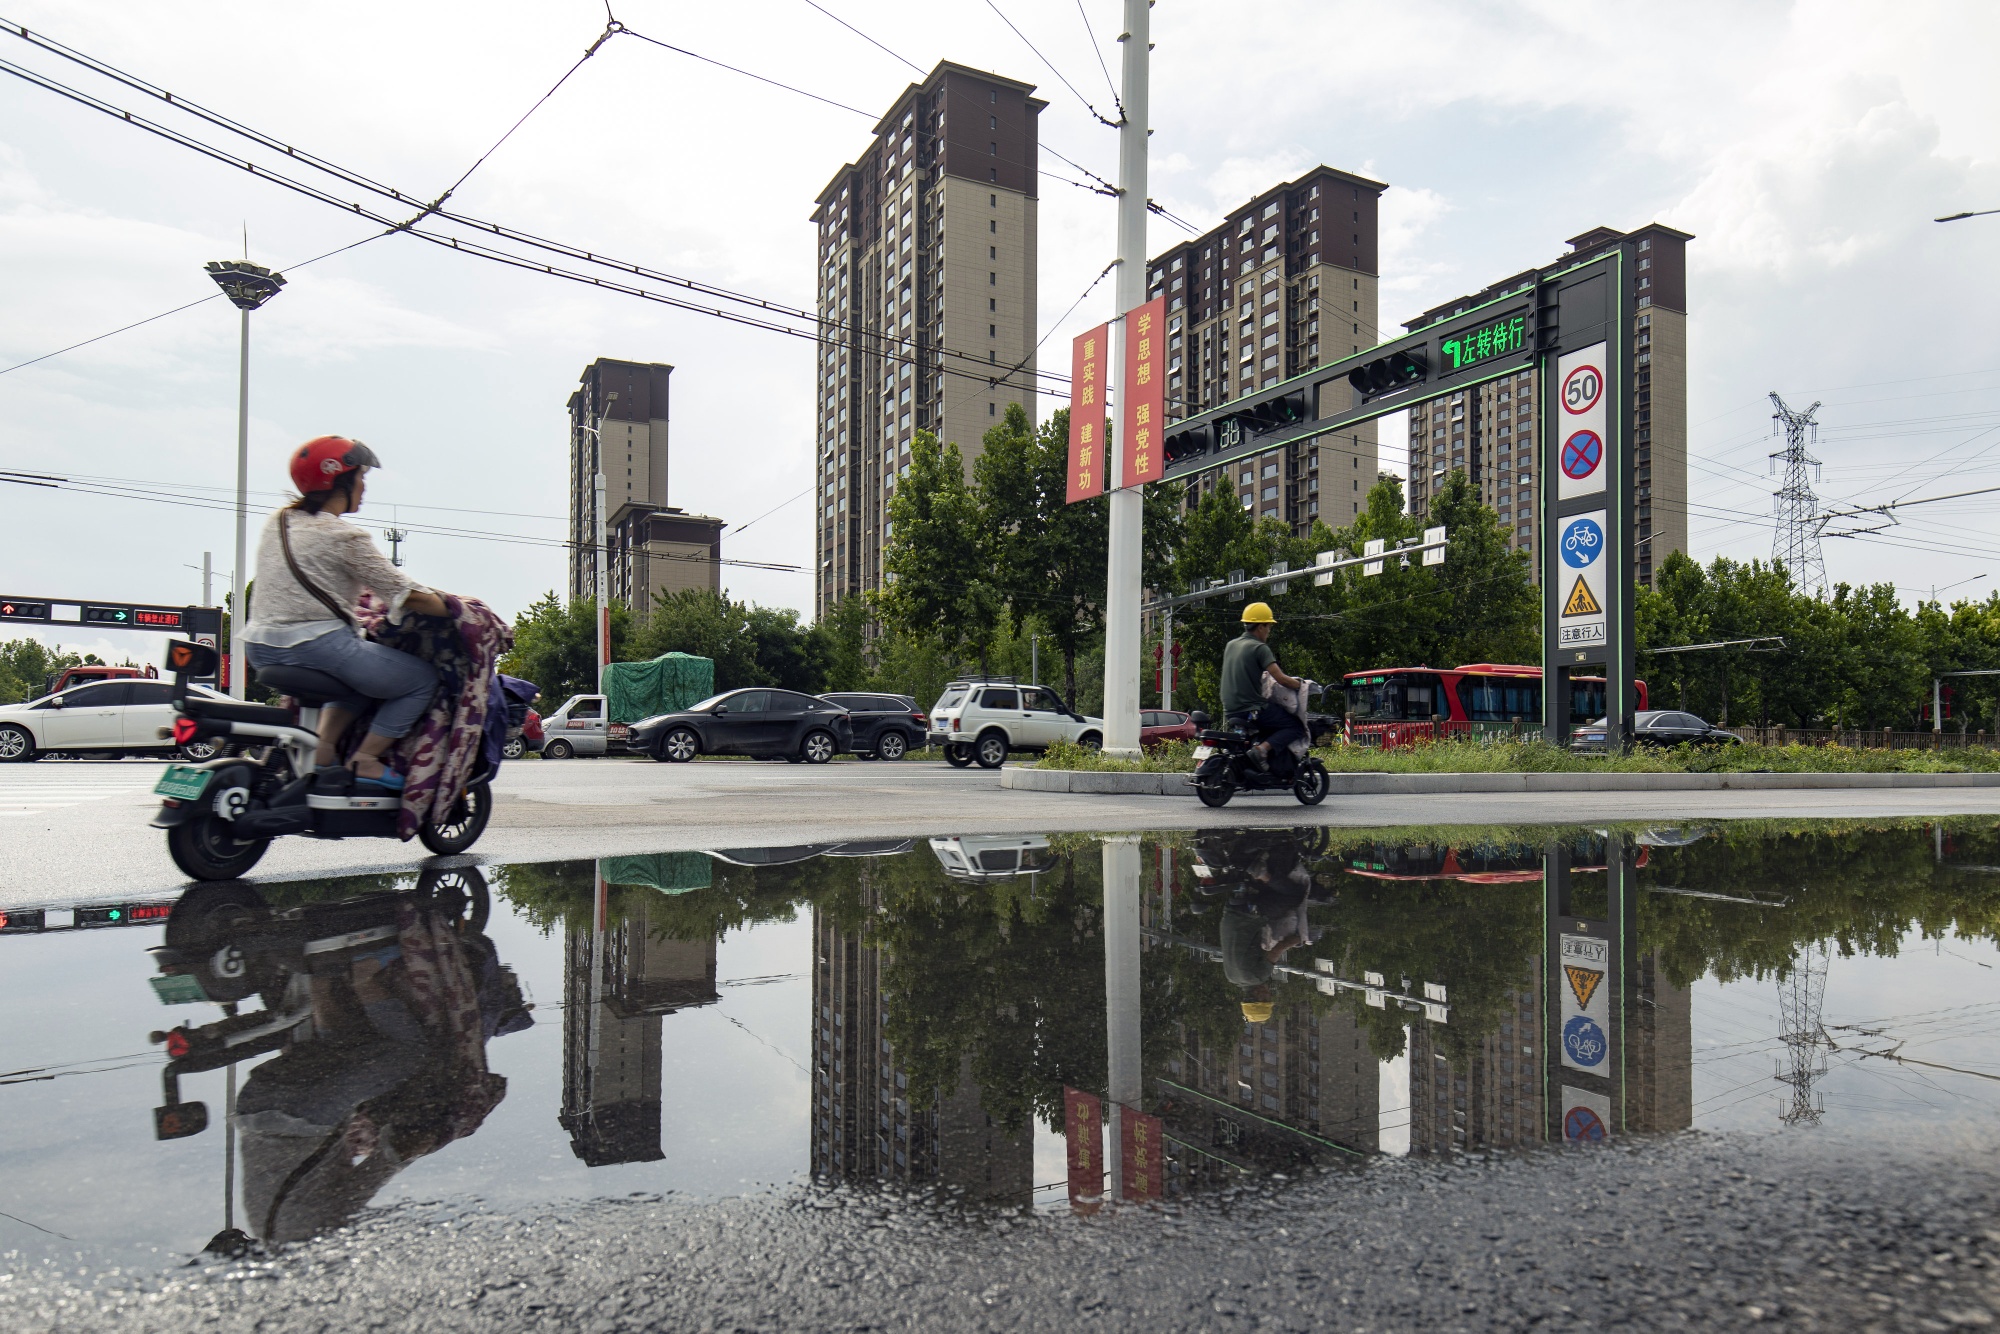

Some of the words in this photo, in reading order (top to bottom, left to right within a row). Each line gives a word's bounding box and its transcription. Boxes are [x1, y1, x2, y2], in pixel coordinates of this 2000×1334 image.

[1136, 312, 1151, 386] 学思想
[1461, 317, 1525, 365] 左转待行
[1081, 338, 1095, 407] 重实践
[1567, 374, 1597, 406] 50
[1078, 423, 1092, 491] 建新功
[1134, 403, 1150, 475] 强党性
[137, 612, 179, 625] 车辆禁止通行
[1561, 625, 1603, 641] 注意行人
